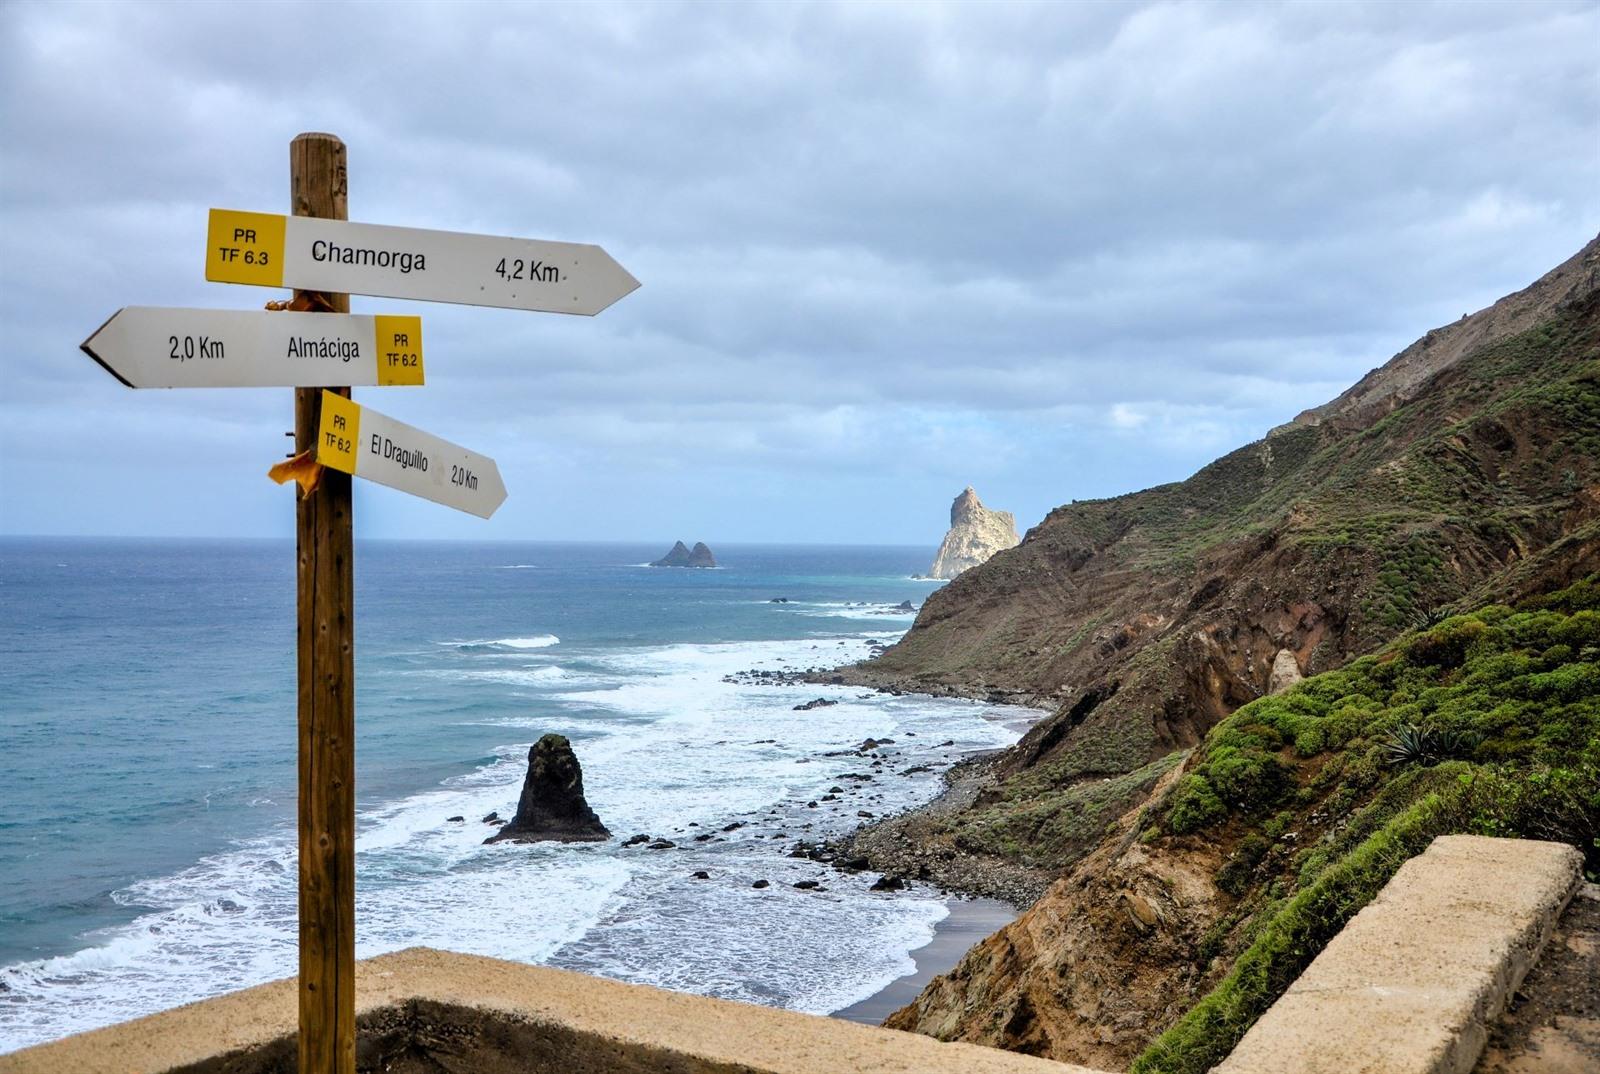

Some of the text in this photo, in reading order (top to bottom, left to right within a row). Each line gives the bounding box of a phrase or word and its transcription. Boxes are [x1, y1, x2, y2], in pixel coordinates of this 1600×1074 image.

[233, 227, 257, 245] PR
[218, 246, 269, 266] TF 6.3
[311, 240, 426, 274] Chamorga
[495, 258, 559, 283] 4,2 Km
[168, 336, 225, 363] 2,0 Km
[287, 336, 360, 363] Almáciga
[393, 333, 409, 348] PR
[386, 353, 418, 368] TF 6.2
[333, 414, 346, 432] PR
[325, 431, 352, 454] TF 6.2
[371, 433, 428, 473] El Draguillo
[451, 464, 479, 492] 2,0 Km
